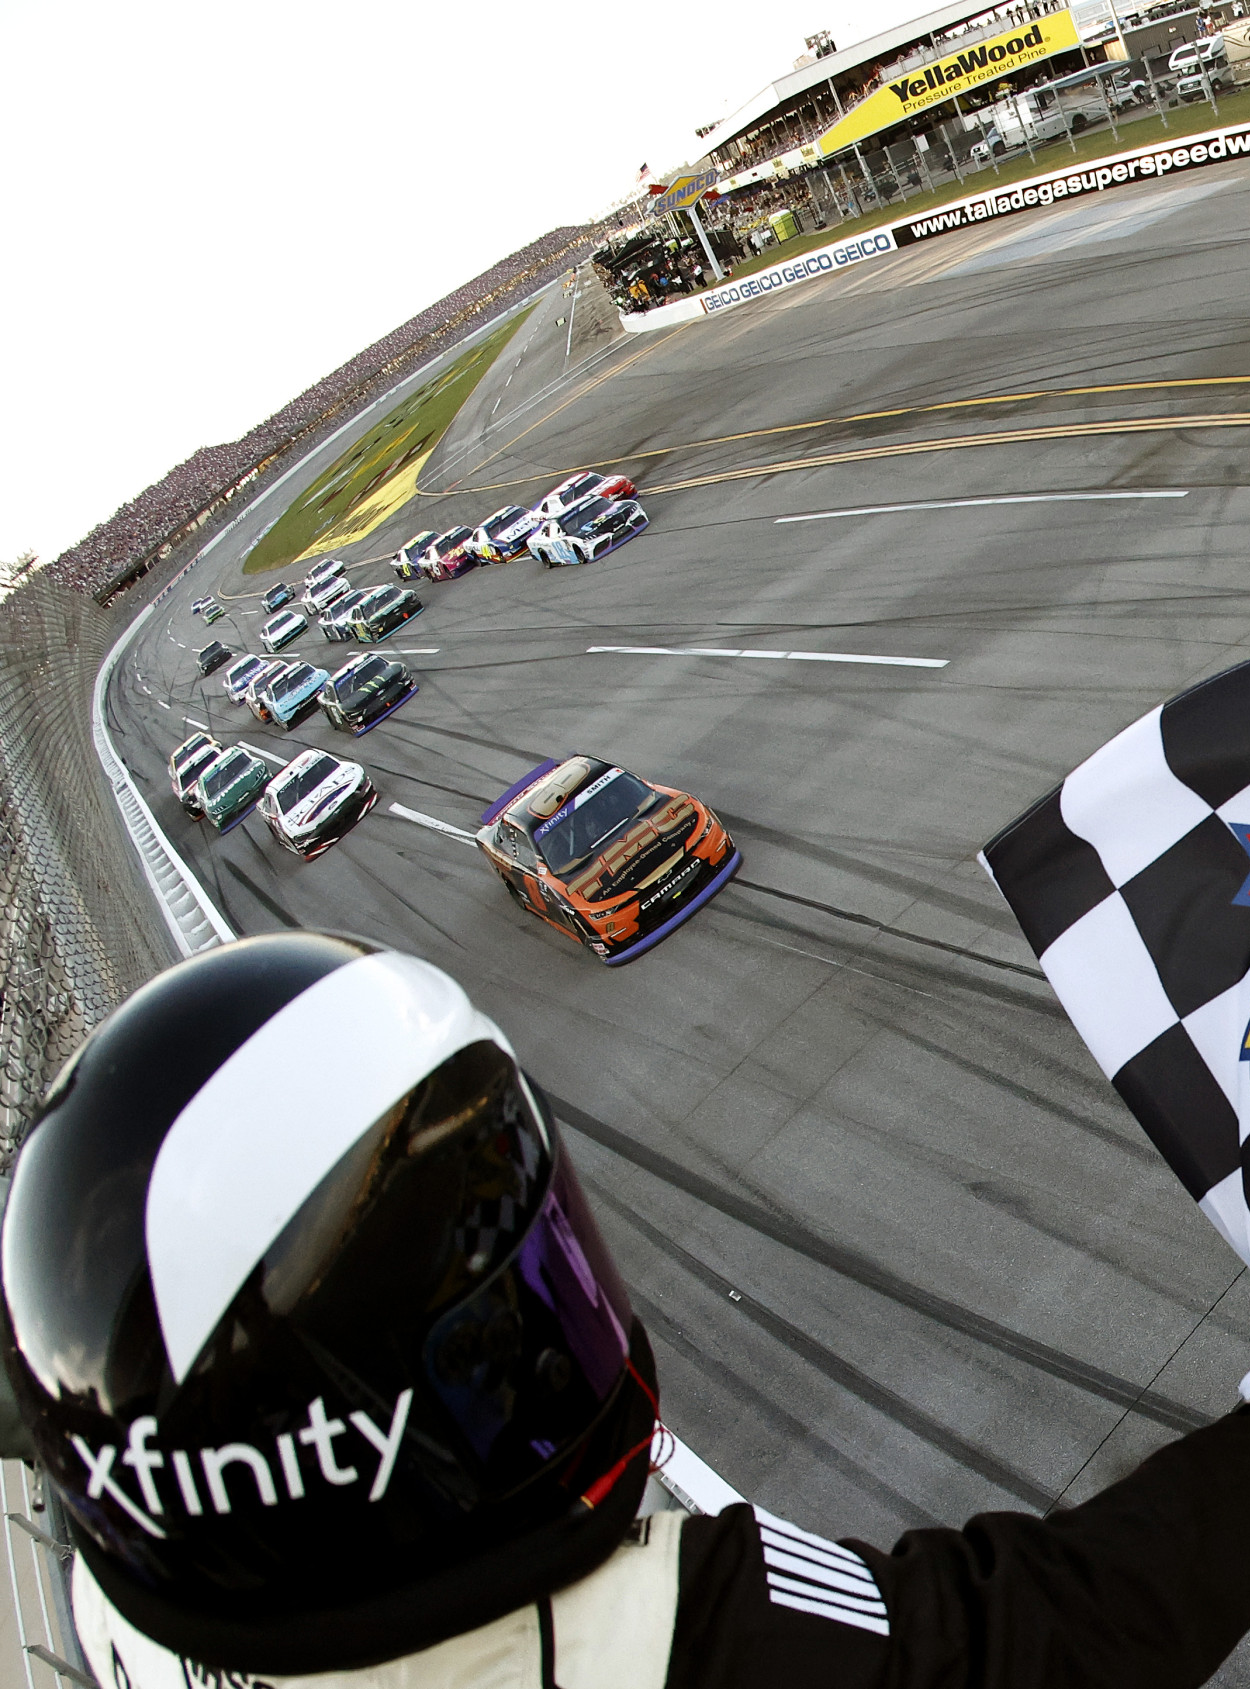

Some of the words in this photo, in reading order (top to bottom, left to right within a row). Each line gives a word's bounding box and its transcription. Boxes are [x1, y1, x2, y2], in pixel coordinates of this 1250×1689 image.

[889, 24, 1043, 103] YellaWood
[903, 81, 962, 114] Pressure
[965, 58, 1015, 86] Treated
[1018, 46, 1047, 64] Pine
[657, 171, 716, 213] SUNOCO
[704, 287, 740, 311] GEICO
[740, 271, 782, 299] GEICO
[782, 253, 832, 284] GEICO
[833, 233, 891, 265] GEICO
[586, 775, 611, 795] SMITH
[539, 807, 568, 834] xfinity
[602, 886, 612, 896] An
[662, 822, 692, 842] Company
[640, 858, 700, 911] CAMARO
[71, 1387, 413, 1539] xfinity
